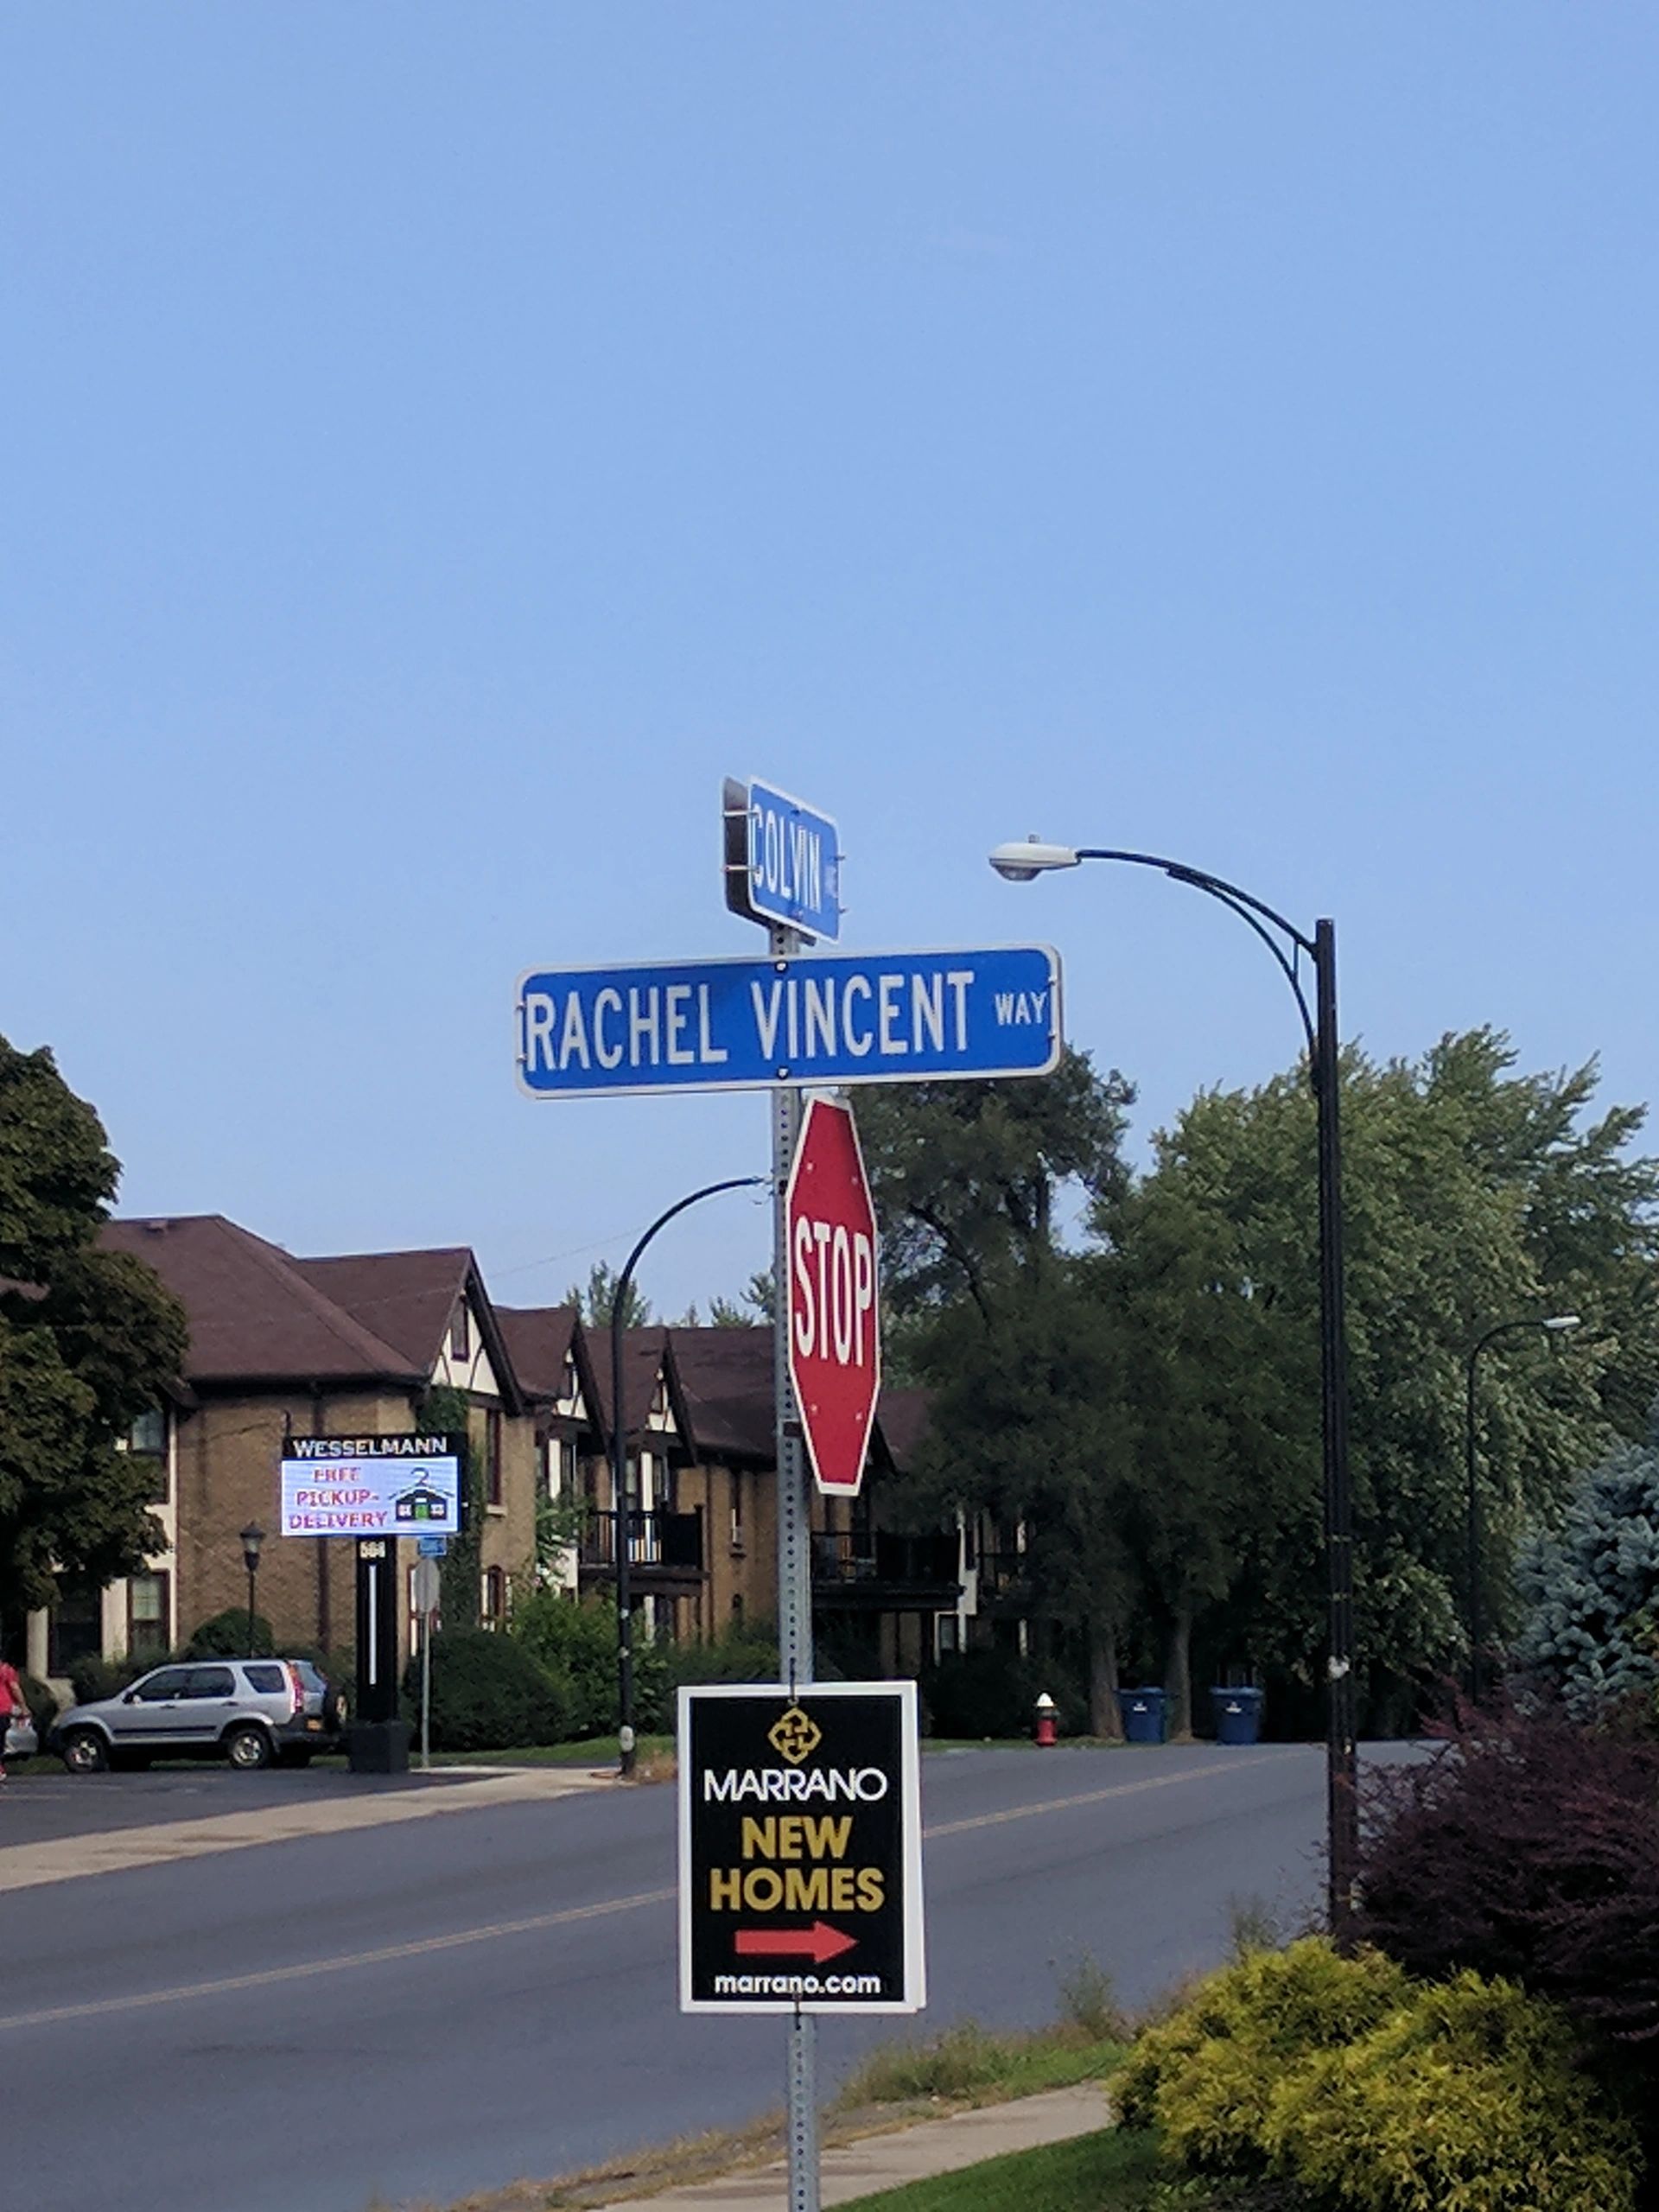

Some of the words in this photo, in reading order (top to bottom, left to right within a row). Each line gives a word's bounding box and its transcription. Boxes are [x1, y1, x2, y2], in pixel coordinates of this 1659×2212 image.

[752, 803, 821, 913] COLVIN
[525, 983, 728, 1071] RACHEL
[750, 970, 975, 1061] VINCENT
[994, 991, 1048, 1027] WAY
[795, 1215, 872, 1367] STOP
[292, 1436, 448, 1458] WESSELMANN
[289, 1510, 389, 1529] DELIVERY
[703, 1766, 888, 1802] MARRANO
[741, 1815, 854, 1860] NEW
[709, 1866, 886, 1912] HOMES
[714, 1974, 882, 1994] marrano.com
